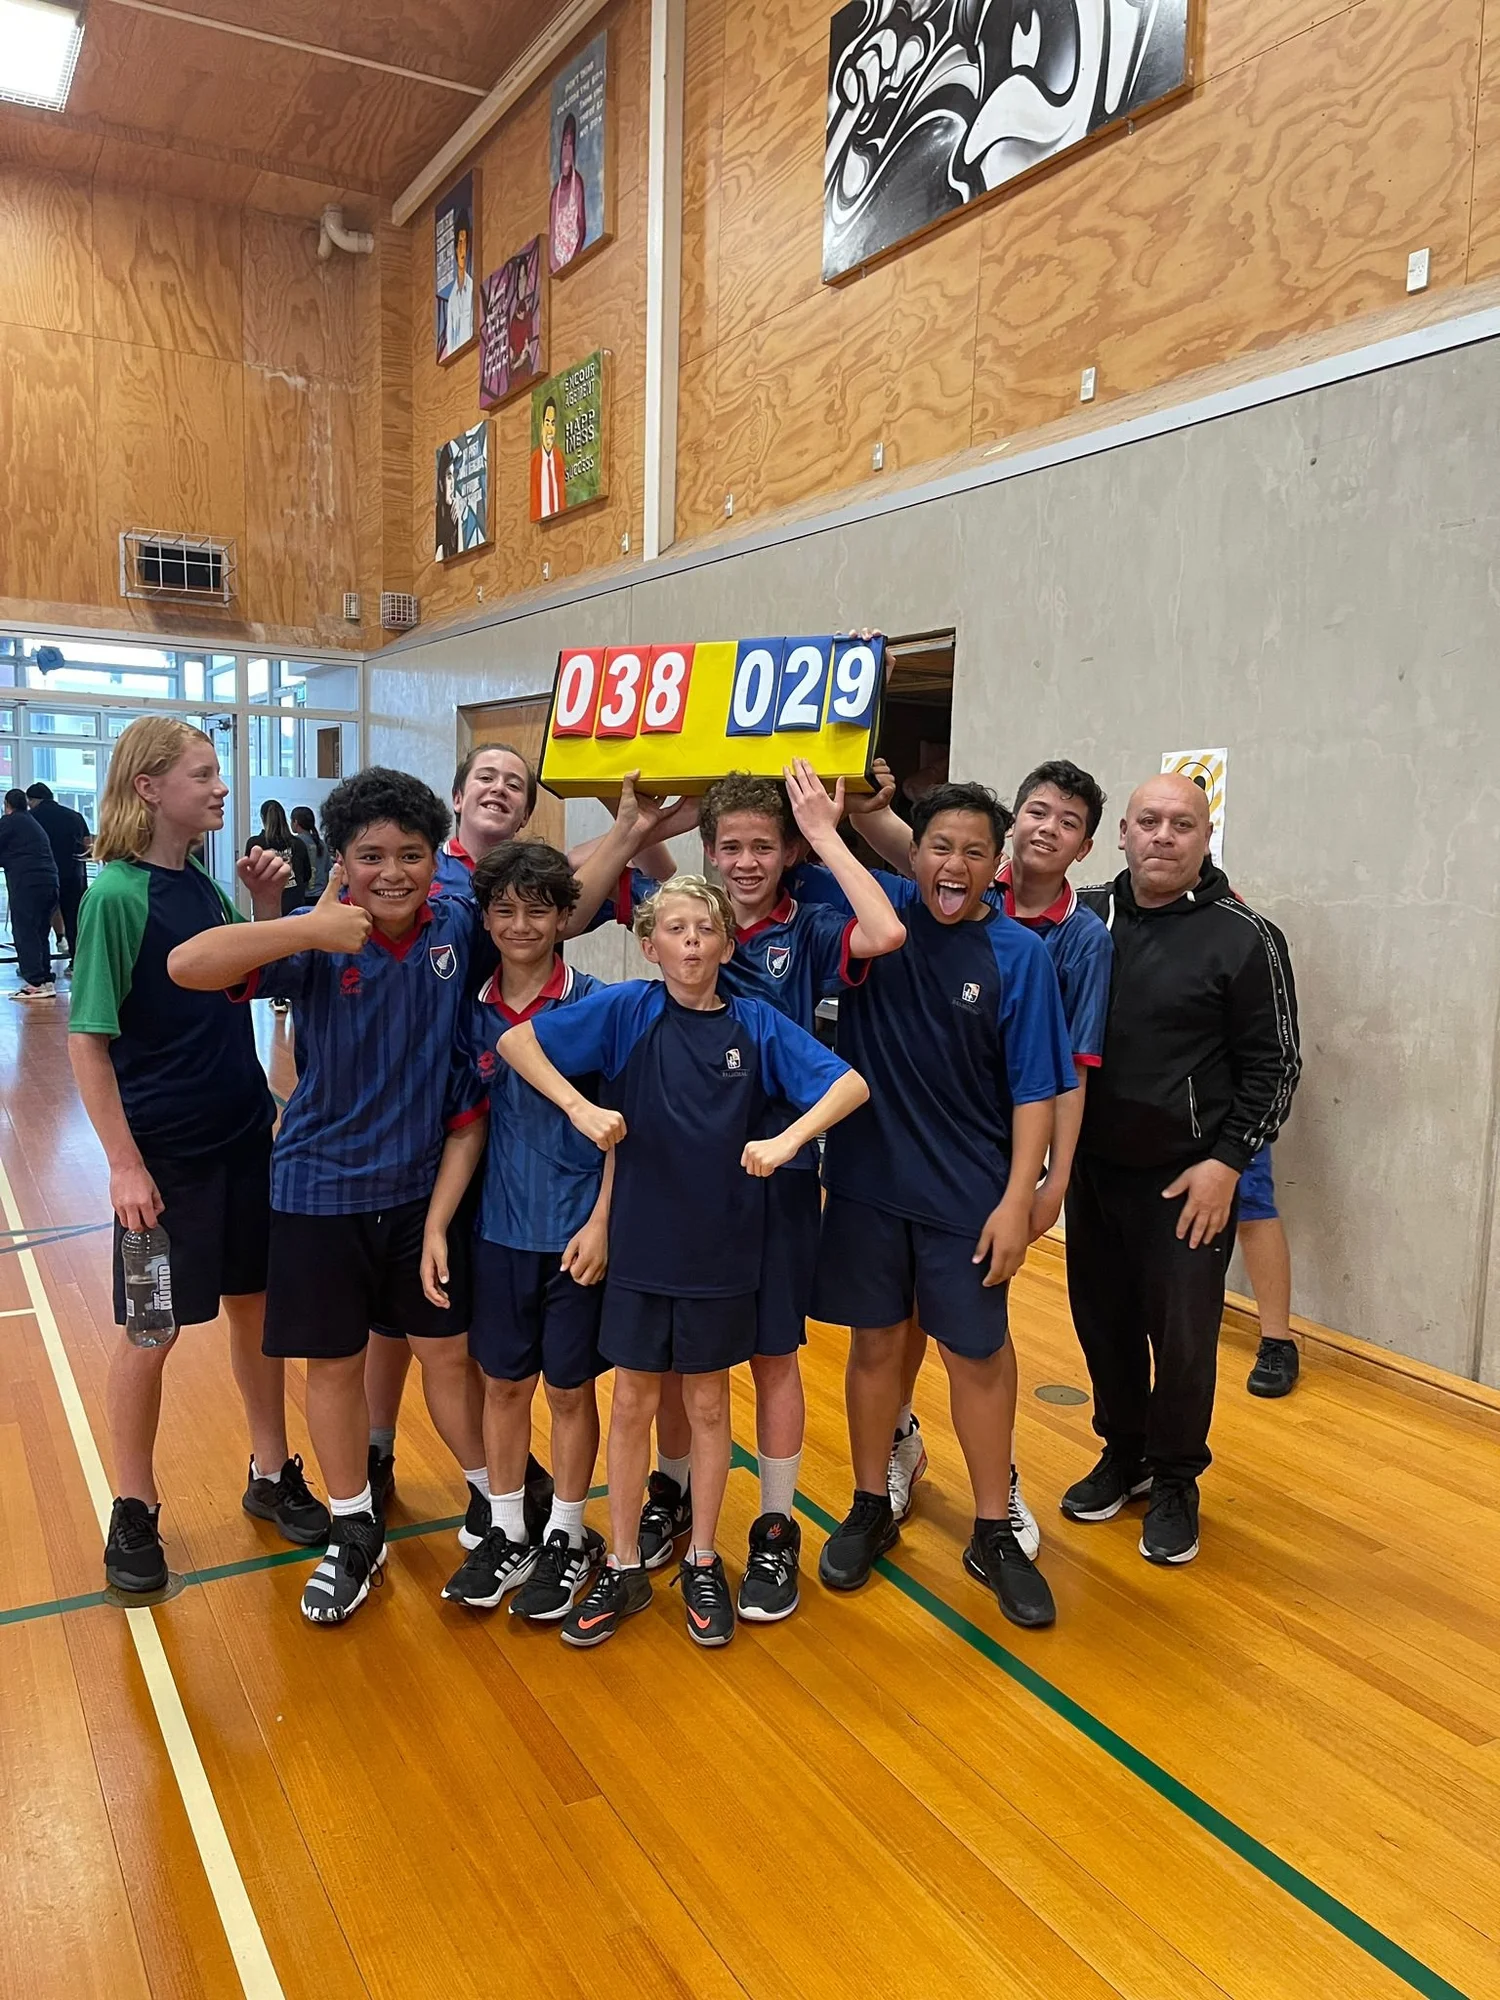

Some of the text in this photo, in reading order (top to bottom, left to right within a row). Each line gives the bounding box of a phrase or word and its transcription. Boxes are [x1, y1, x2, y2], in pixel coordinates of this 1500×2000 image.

[564, 363, 595, 392] ENCOUR
[564, 408, 595, 437] HAPP
[564, 424, 595, 455] INESS
[564, 455, 595, 482] SUCCESS
[556, 645, 876, 728] 038 029
